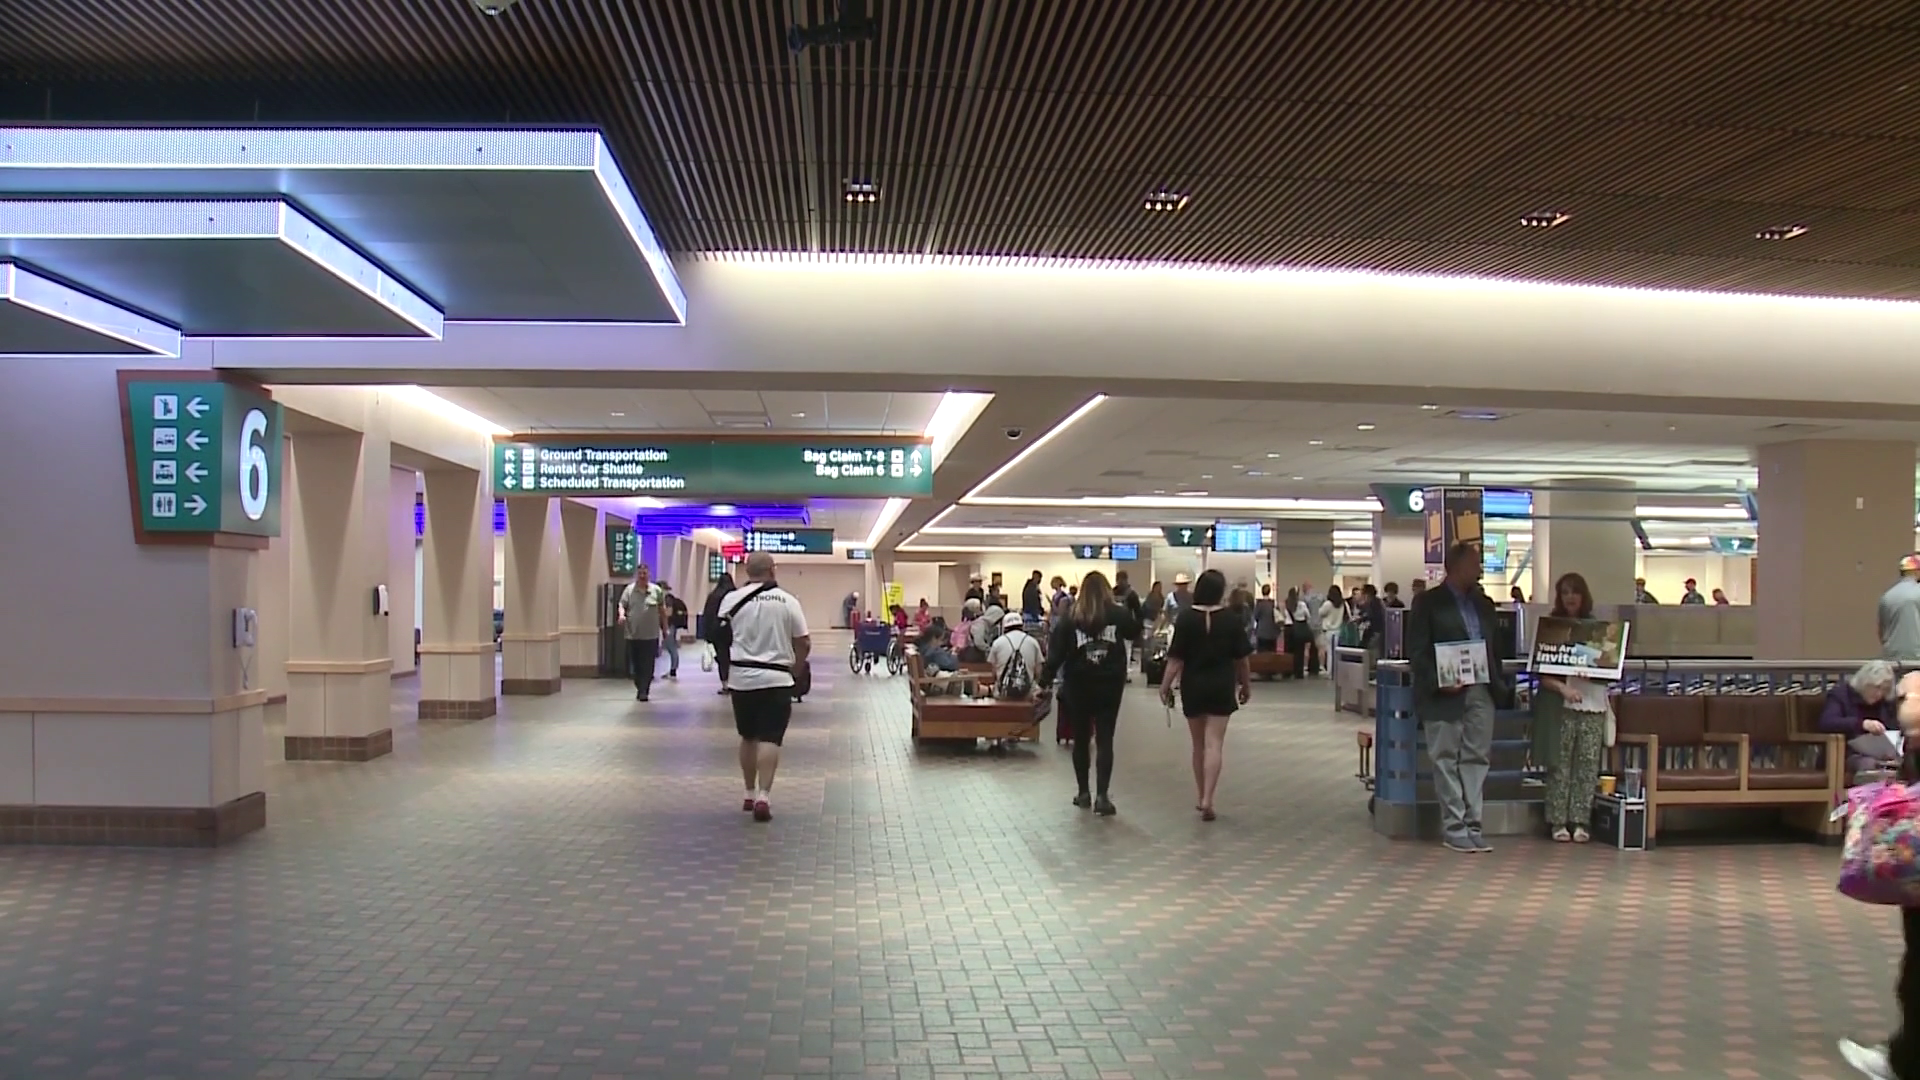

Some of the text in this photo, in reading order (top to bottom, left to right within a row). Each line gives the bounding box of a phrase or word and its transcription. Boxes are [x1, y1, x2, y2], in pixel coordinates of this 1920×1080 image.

[540, 449, 668, 462] Ground Transportation
[804, 450, 885, 464] Bag Claim 7-8
[239, 409, 268, 520] 6
[540, 463, 644, 474] Rental Car Shuttle
[815, 464, 885, 478] Bag Claim 6
[540, 476, 685, 490] Scheduled Transportation
[1409, 490, 1424, 512] 6
[1180, 529, 1192, 544] 7
[1731, 540, 1740, 550] 7
[1538, 643, 1577, 654] You Are
[1536, 651, 1588, 666] Invited
